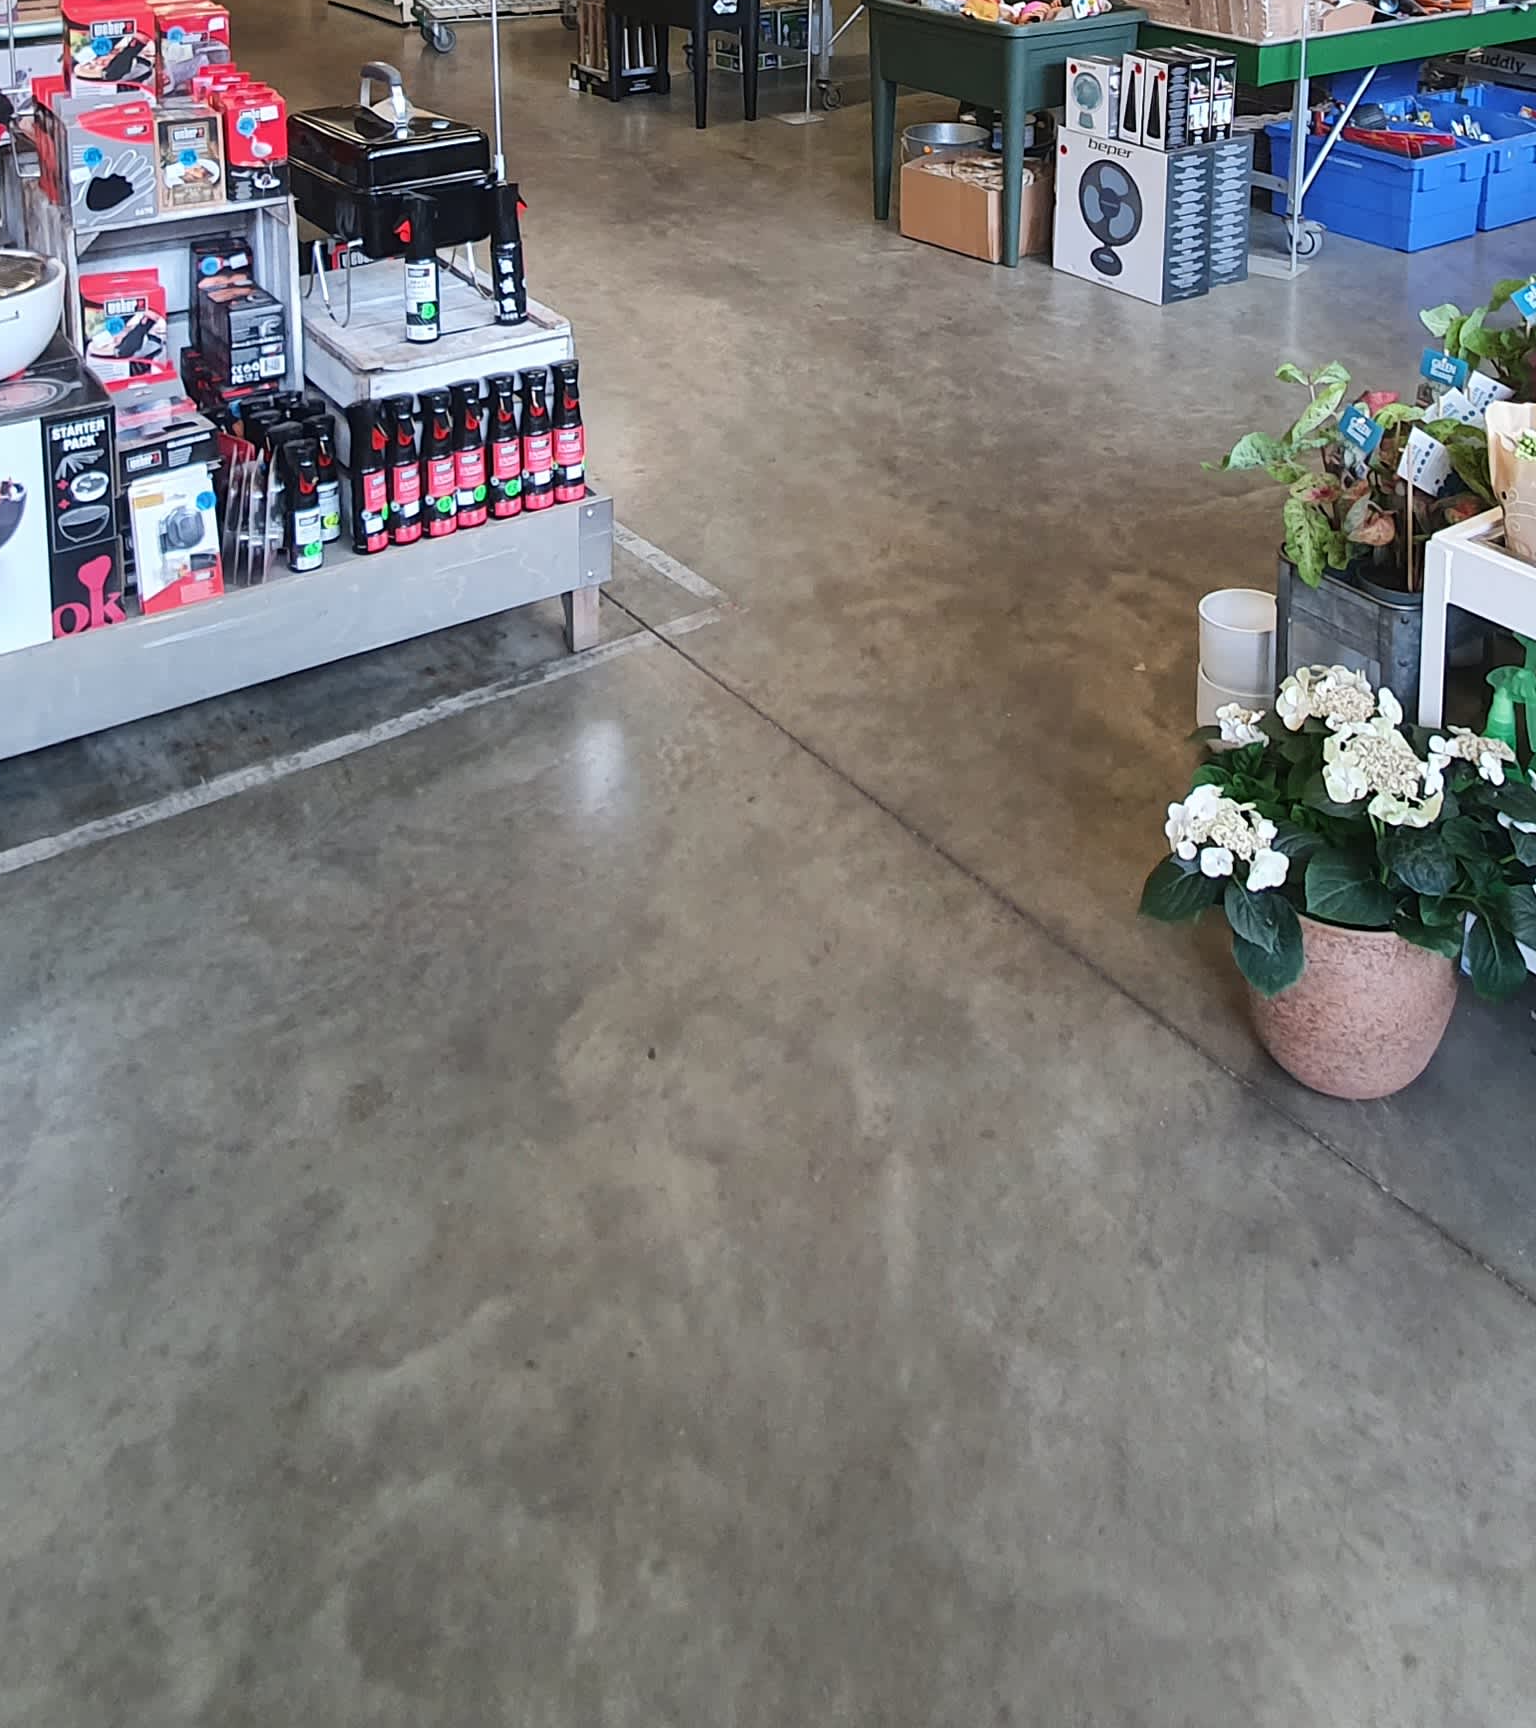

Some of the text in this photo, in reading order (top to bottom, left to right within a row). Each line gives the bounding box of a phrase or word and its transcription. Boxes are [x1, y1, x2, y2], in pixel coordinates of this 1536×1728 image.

[93, 22, 125, 37] weber
[1469, 53, 1527, 73] Cuddly
[173, 129, 198, 140] weber
[1087, 136, 1135, 159] beper
[107, 301, 136, 315] weber
[51, 419, 106, 441] STARTER
[63, 433, 97, 451] PACK
[128, 456, 153, 470] weber
[52, 554, 128, 639] ok
